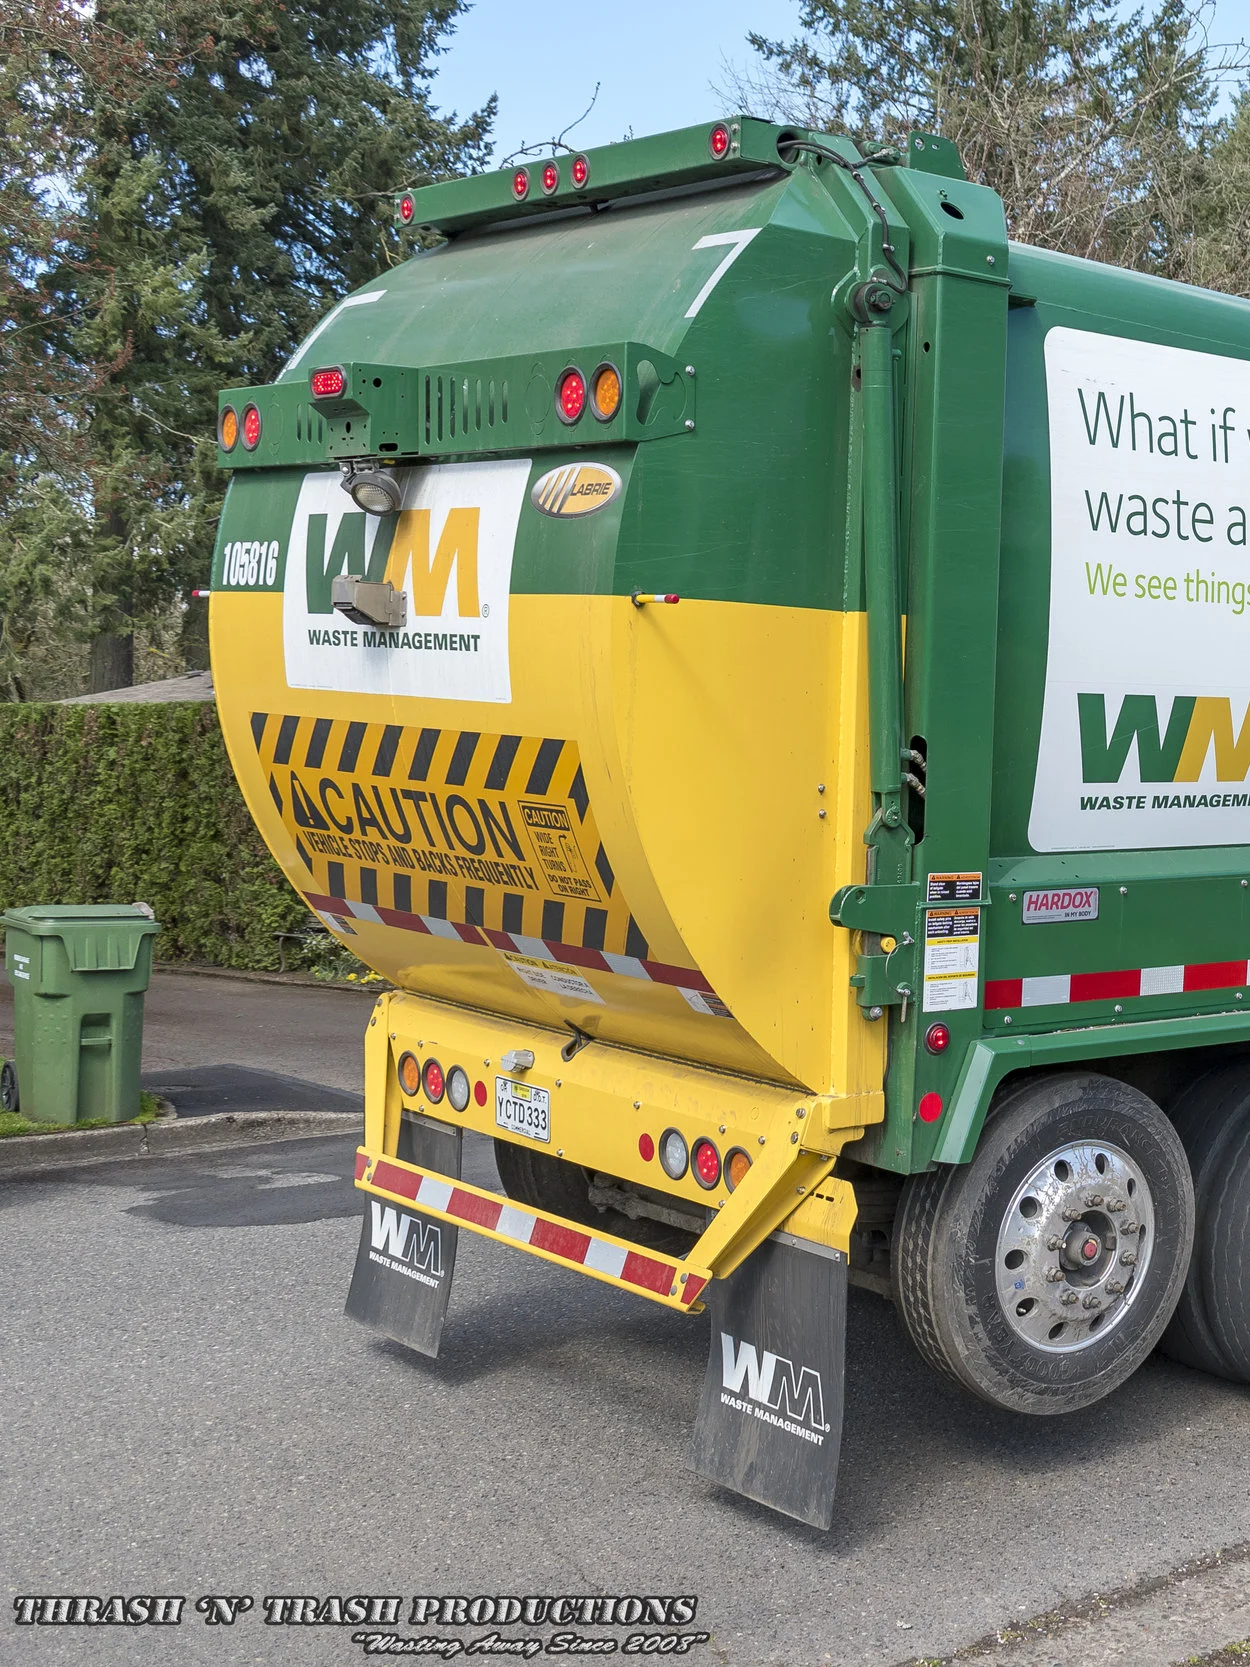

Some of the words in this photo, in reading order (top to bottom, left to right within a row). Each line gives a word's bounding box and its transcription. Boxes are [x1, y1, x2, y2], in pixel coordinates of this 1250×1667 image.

[1077, 388, 1198, 461] What
[1210, 407, 1236, 464] if
[570, 482, 612, 496] LABRIE
[1084, 489, 1214, 543] waste
[1226, 505, 1248, 547] a
[222, 540, 279, 586] 105816
[306, 507, 480, 618] WM
[1085, 562, 1127, 598] We
[1134, 574, 1178, 601] see
[308, 629, 358, 647] WASTE
[363, 631, 480, 652] MANAGEMENT
[319, 778, 526, 862] CAUTION
[524, 808, 569, 829] CAUTION
[1080, 795, 1146, 811] WASTE
[534, 831, 554, 844] WIDE
[539, 845, 559, 858] RIGHT
[303, 830, 354, 859] VEHICLE
[349, 837, 390, 866] STOPS
[387, 845, 416, 869] AND
[412, 848, 459, 877] BACKS
[454, 856, 540, 891] FREQUENTLY
[542, 858, 567, 872] TURNS
[548, 874, 559, 883] DO
[558, 875, 574, 885] NOT
[573, 877, 592, 888] PASS
[569, 886, 590, 897] RIGHT
[1026, 891, 1094, 911] HARDOX
[371, 1200, 441, 1276] WM
[369, 1250, 391, 1267] WASTE
[391, 1261, 440, 1289] MANAGEMENT
[720, 1331, 825, 1431] WM
[720, 1392, 753, 1414] WASTE
[753, 1407, 824, 1446] MANAGEMENT
